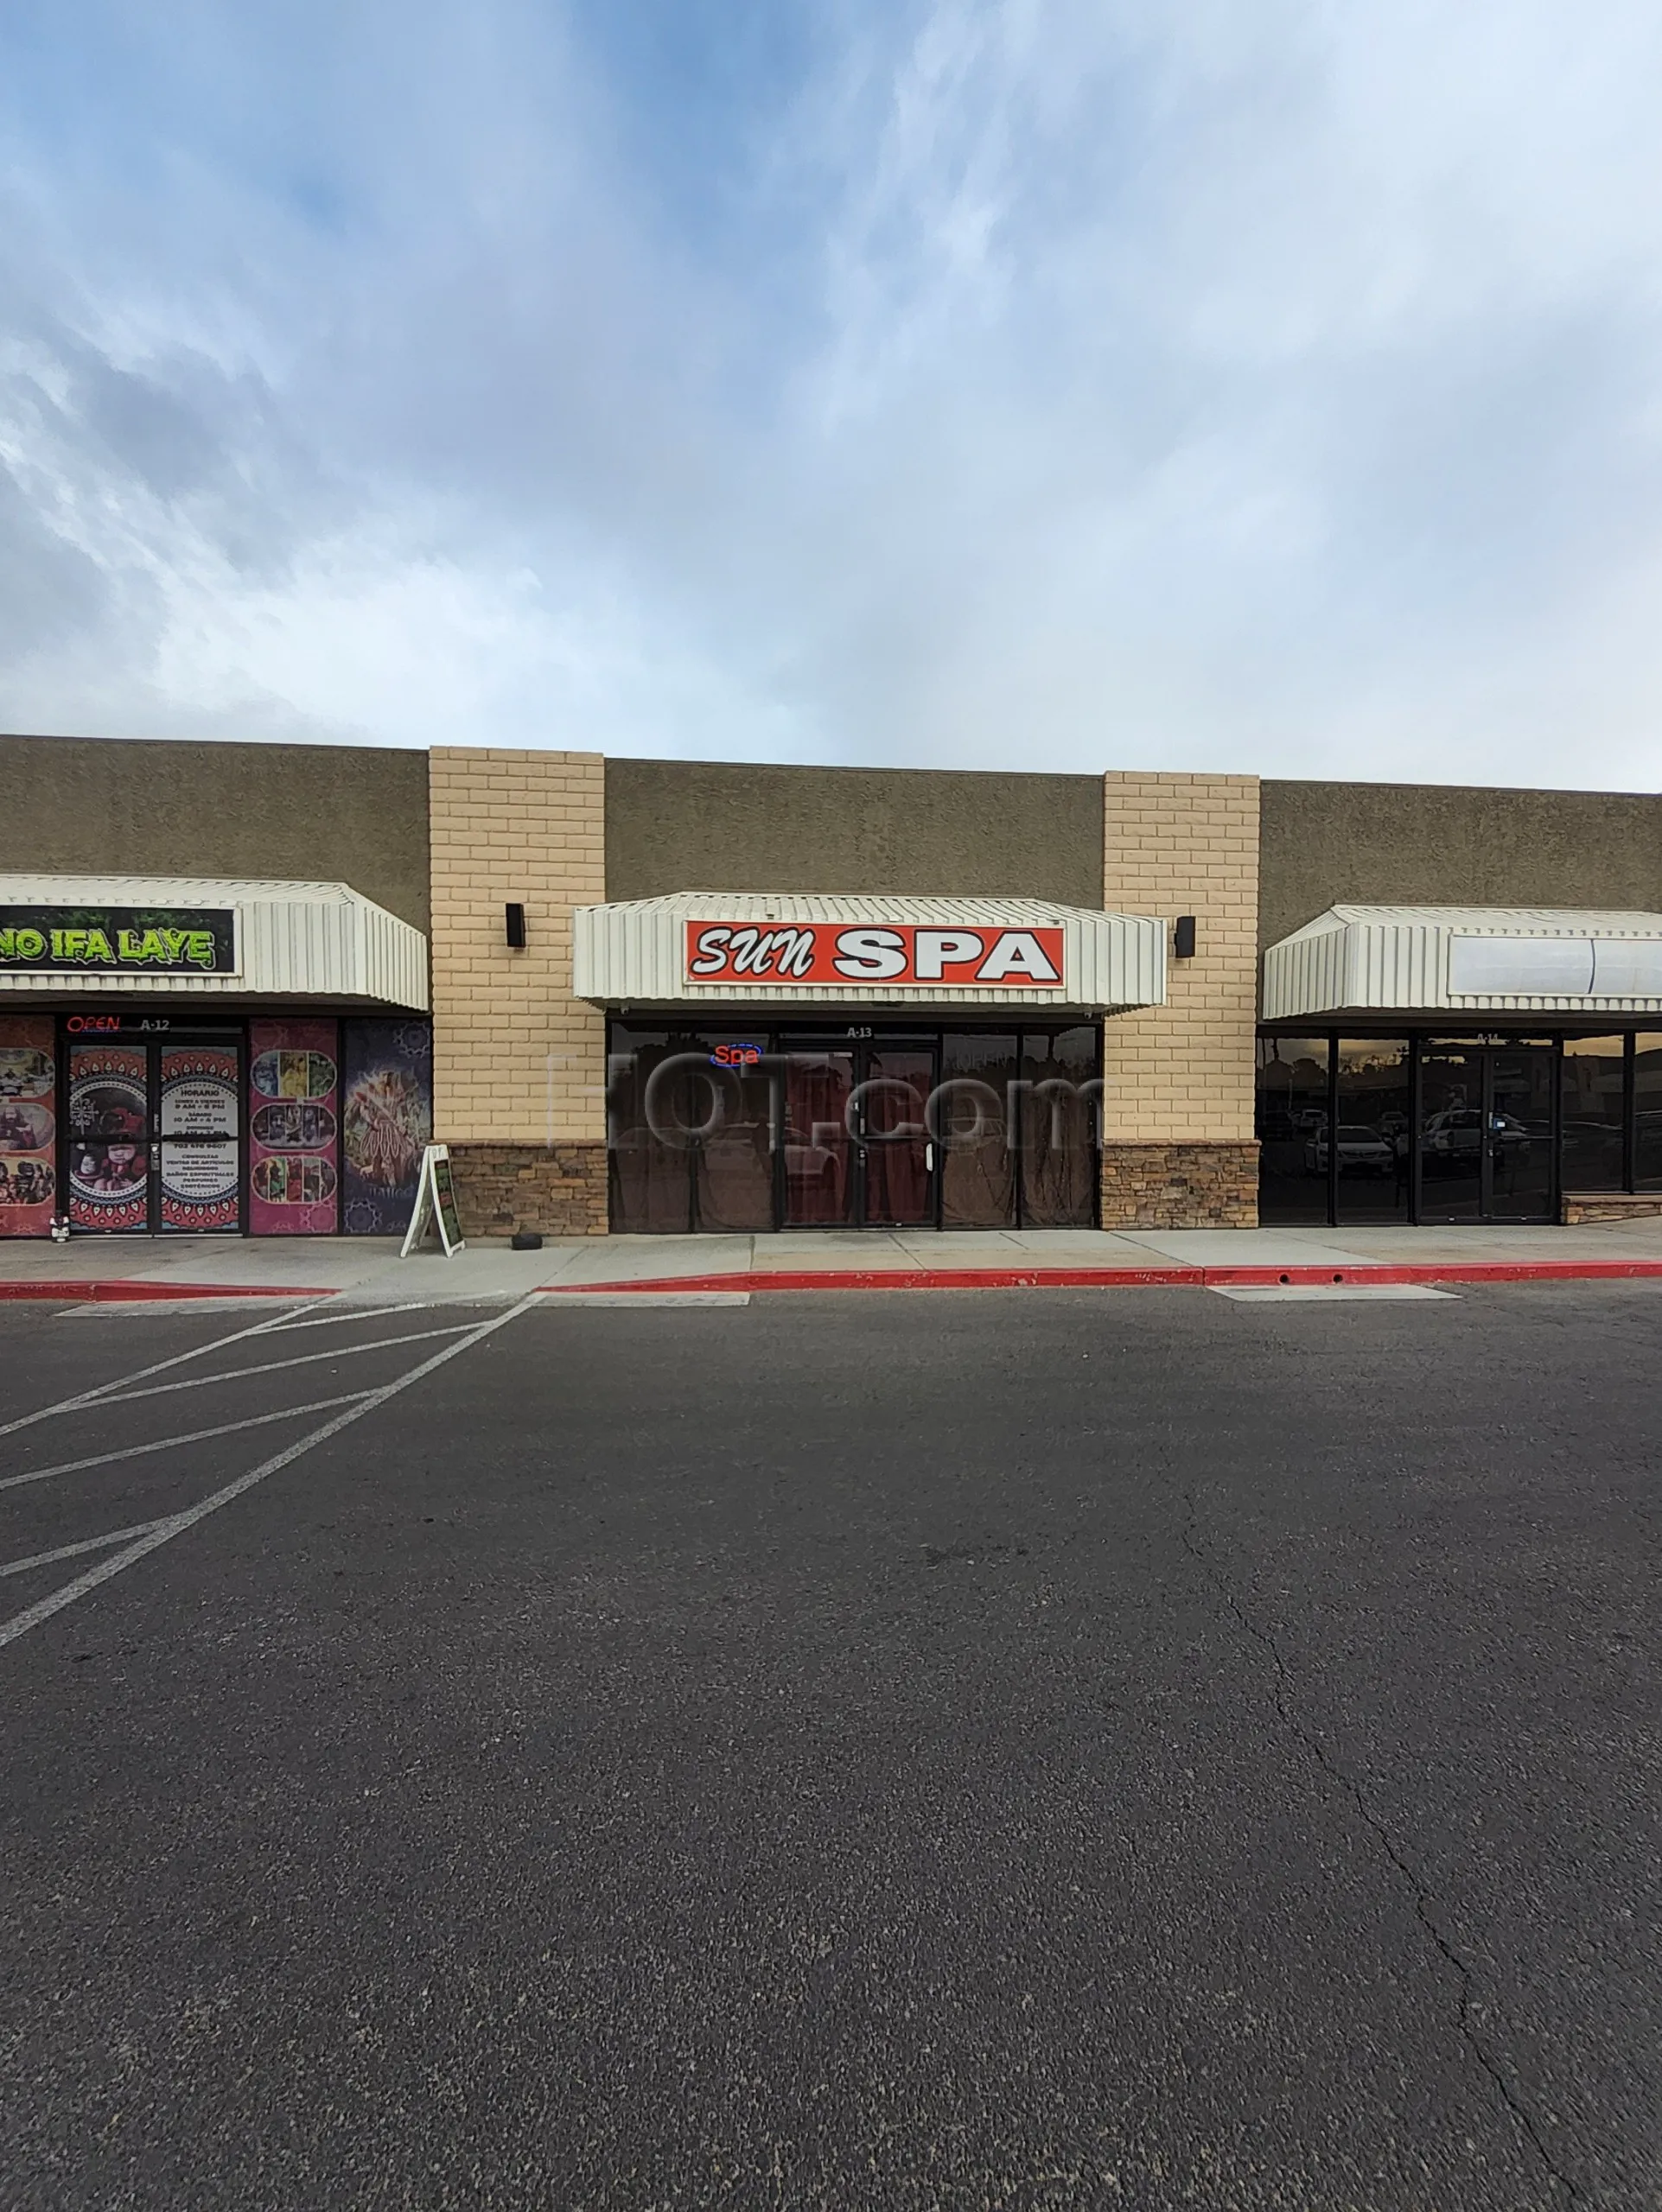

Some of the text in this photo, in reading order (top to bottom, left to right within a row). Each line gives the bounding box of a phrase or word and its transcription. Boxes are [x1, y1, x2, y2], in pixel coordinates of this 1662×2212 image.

[50, 928, 117, 964] IFA
[117, 927, 216, 969] LAYE
[832, 927, 1061, 982] SPA
[67, 1016, 120, 1032] OPEN
[715, 1045, 759, 1064] Spa
